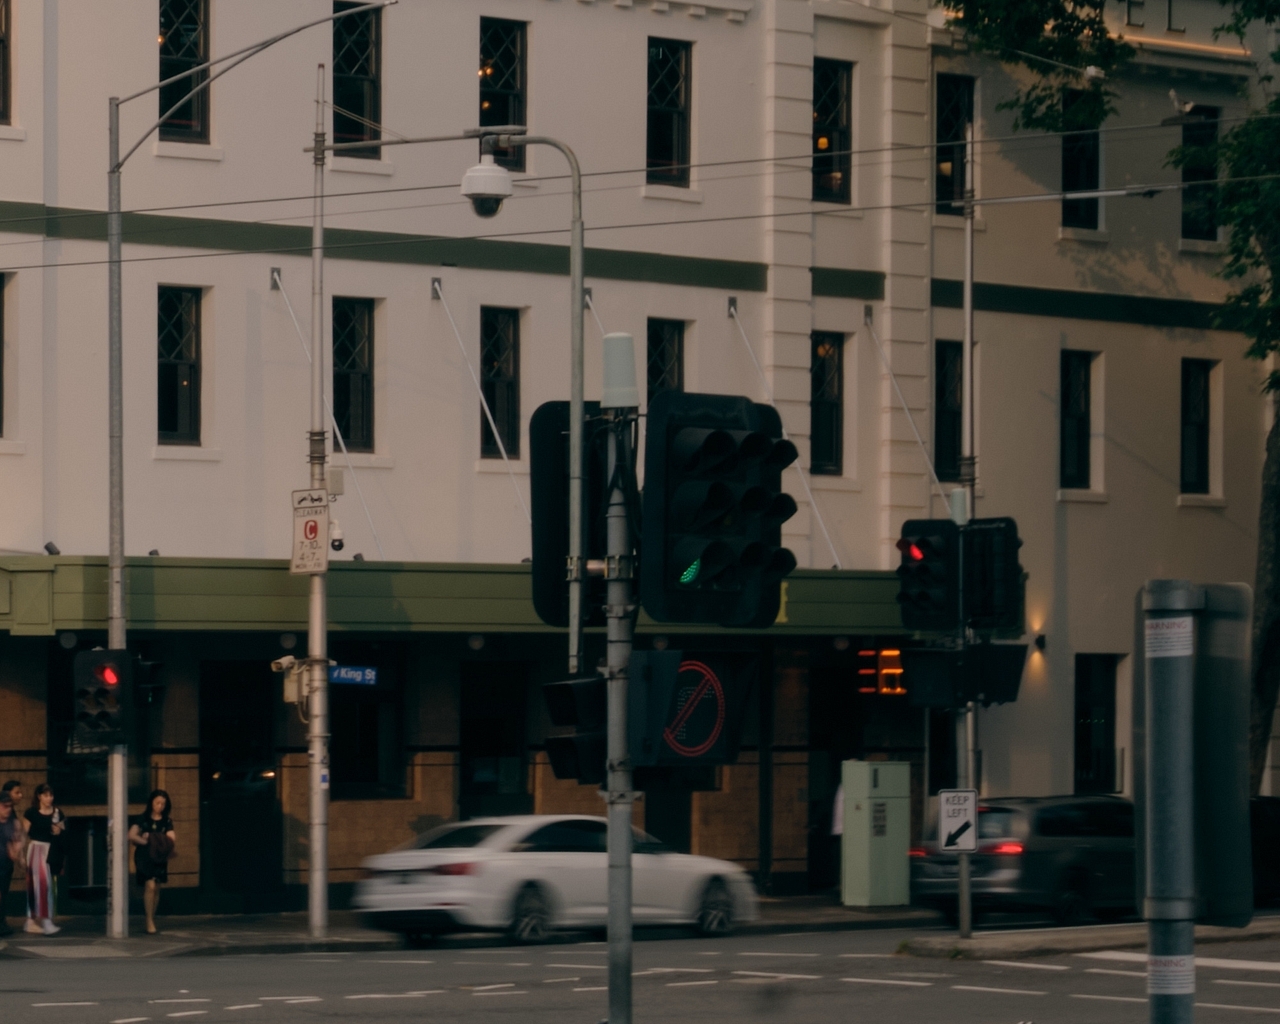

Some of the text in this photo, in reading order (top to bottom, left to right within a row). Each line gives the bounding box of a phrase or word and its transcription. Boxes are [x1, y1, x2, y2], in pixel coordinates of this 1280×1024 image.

[340, 667, 376, 682] King St
[946, 794, 969, 805] KEEP
[947, 808, 968, 818] LEFT
